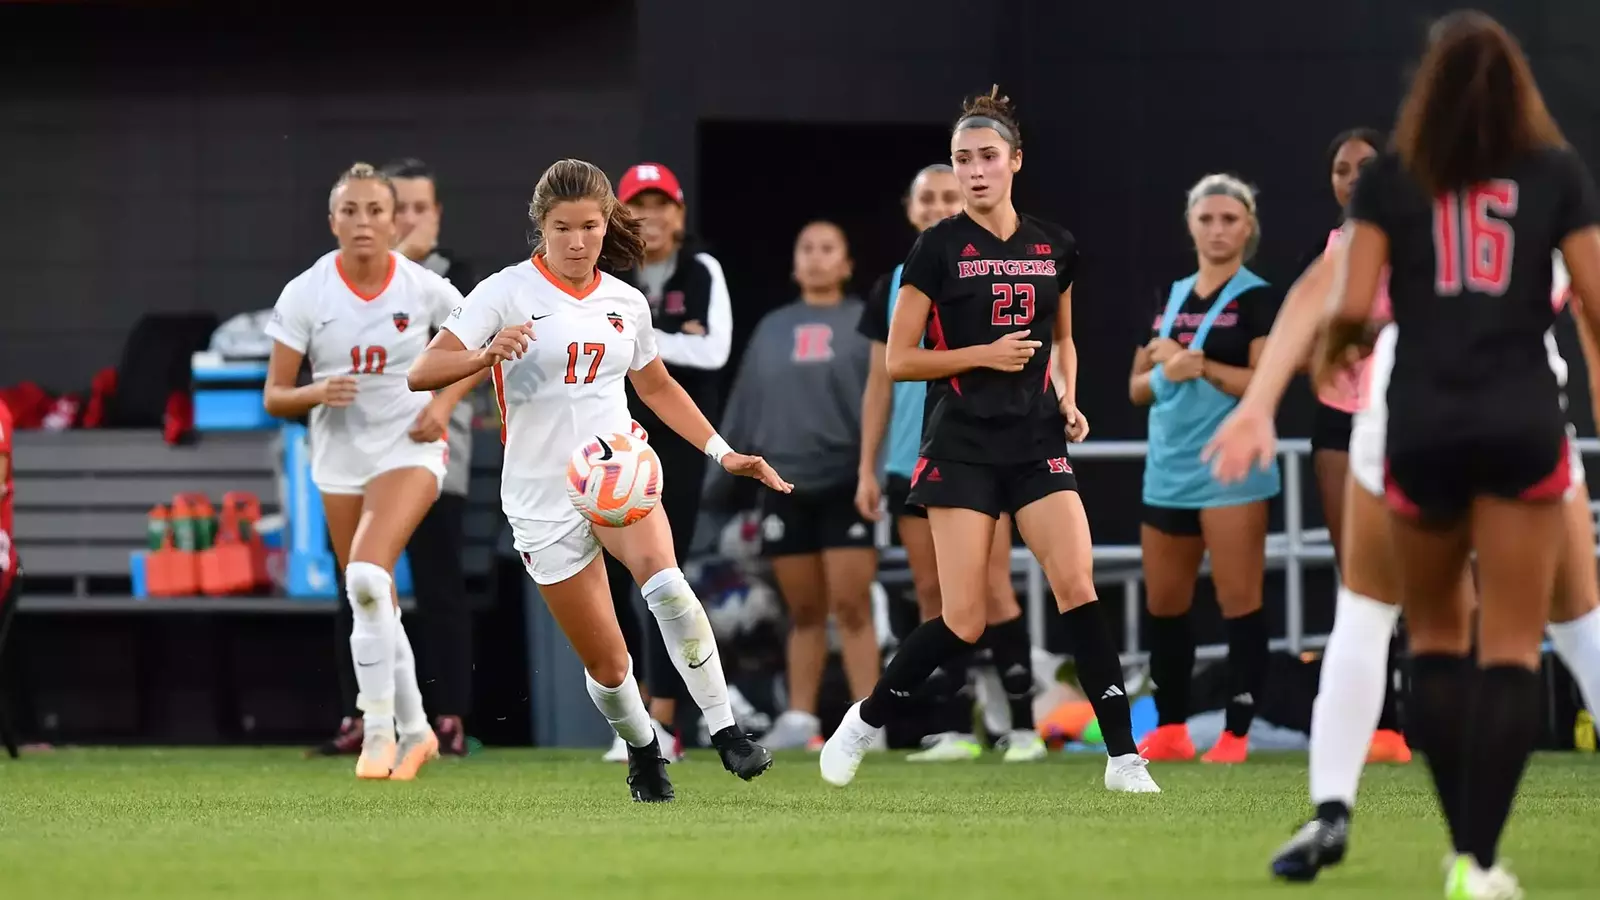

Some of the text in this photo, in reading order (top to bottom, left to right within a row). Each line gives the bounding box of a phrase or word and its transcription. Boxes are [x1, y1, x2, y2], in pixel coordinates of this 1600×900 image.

[637, 164, 661, 181] R
[1432, 178, 1519, 297] 16
[958, 259, 1056, 278] RUTGERS
[991, 283, 1036, 326] 23
[349, 344, 387, 375] 10
[792, 323, 835, 362] R
[564, 341, 606, 385] 17
